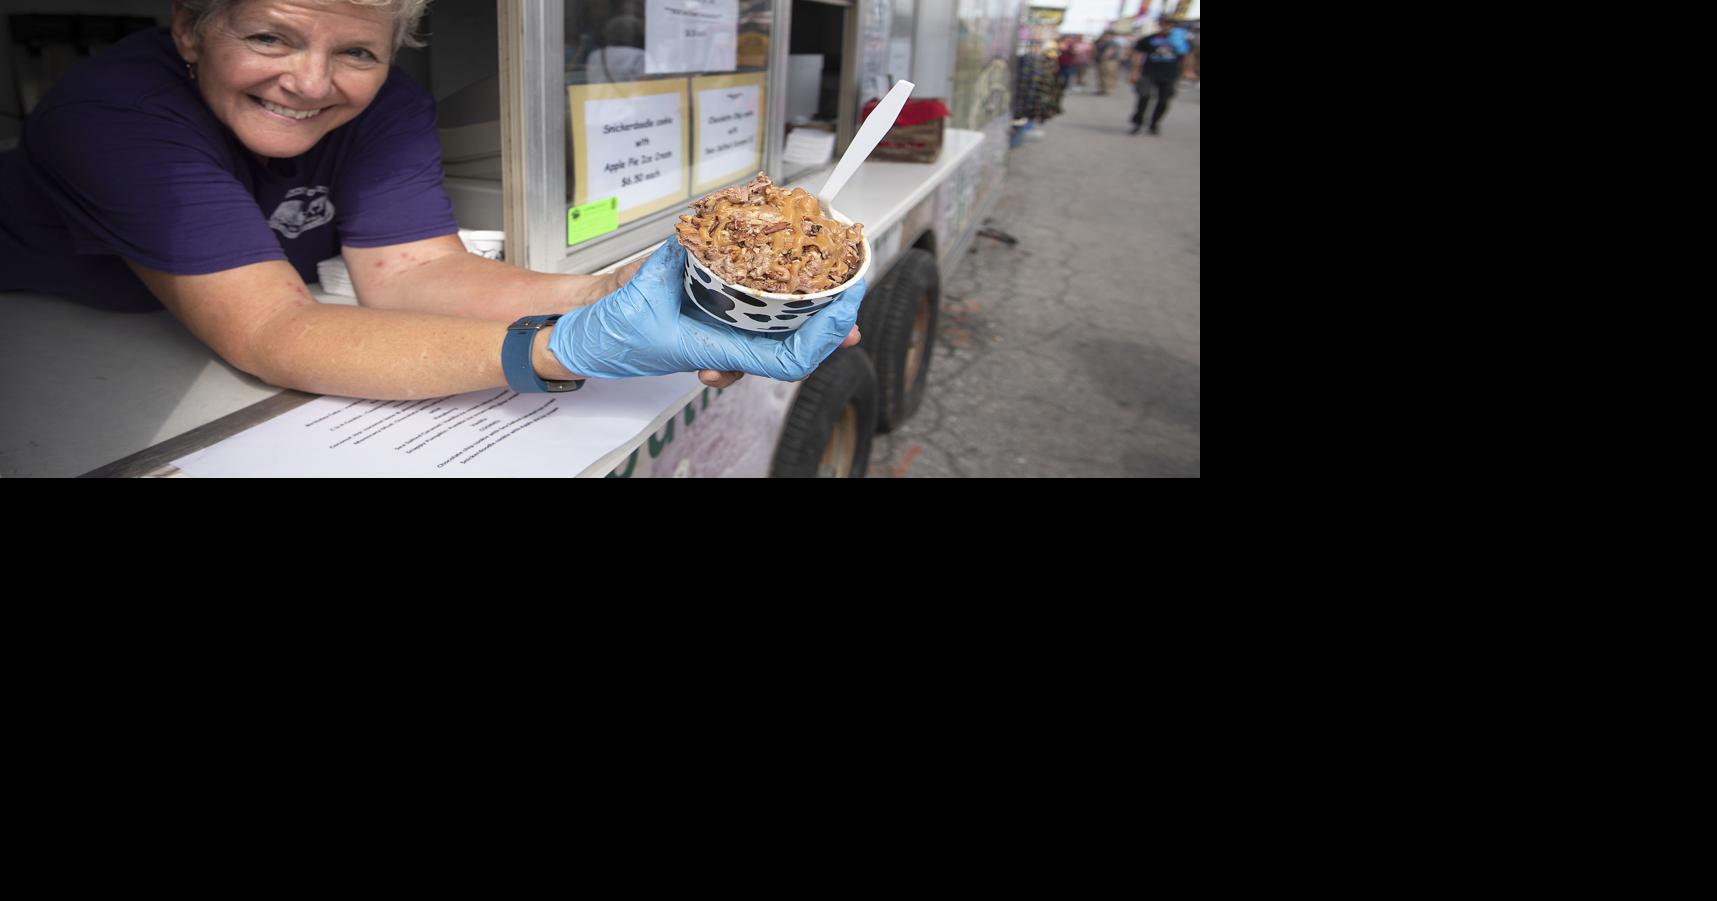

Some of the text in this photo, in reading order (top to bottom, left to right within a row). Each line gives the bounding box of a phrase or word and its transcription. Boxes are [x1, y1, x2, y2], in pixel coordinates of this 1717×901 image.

[603, 120, 653, 134] Snickerdoodle
[635, 137, 650, 147] with
[604, 151, 673, 173] Apple Pie Ice Cream
[621, 170, 661, 187] $6.50 each
